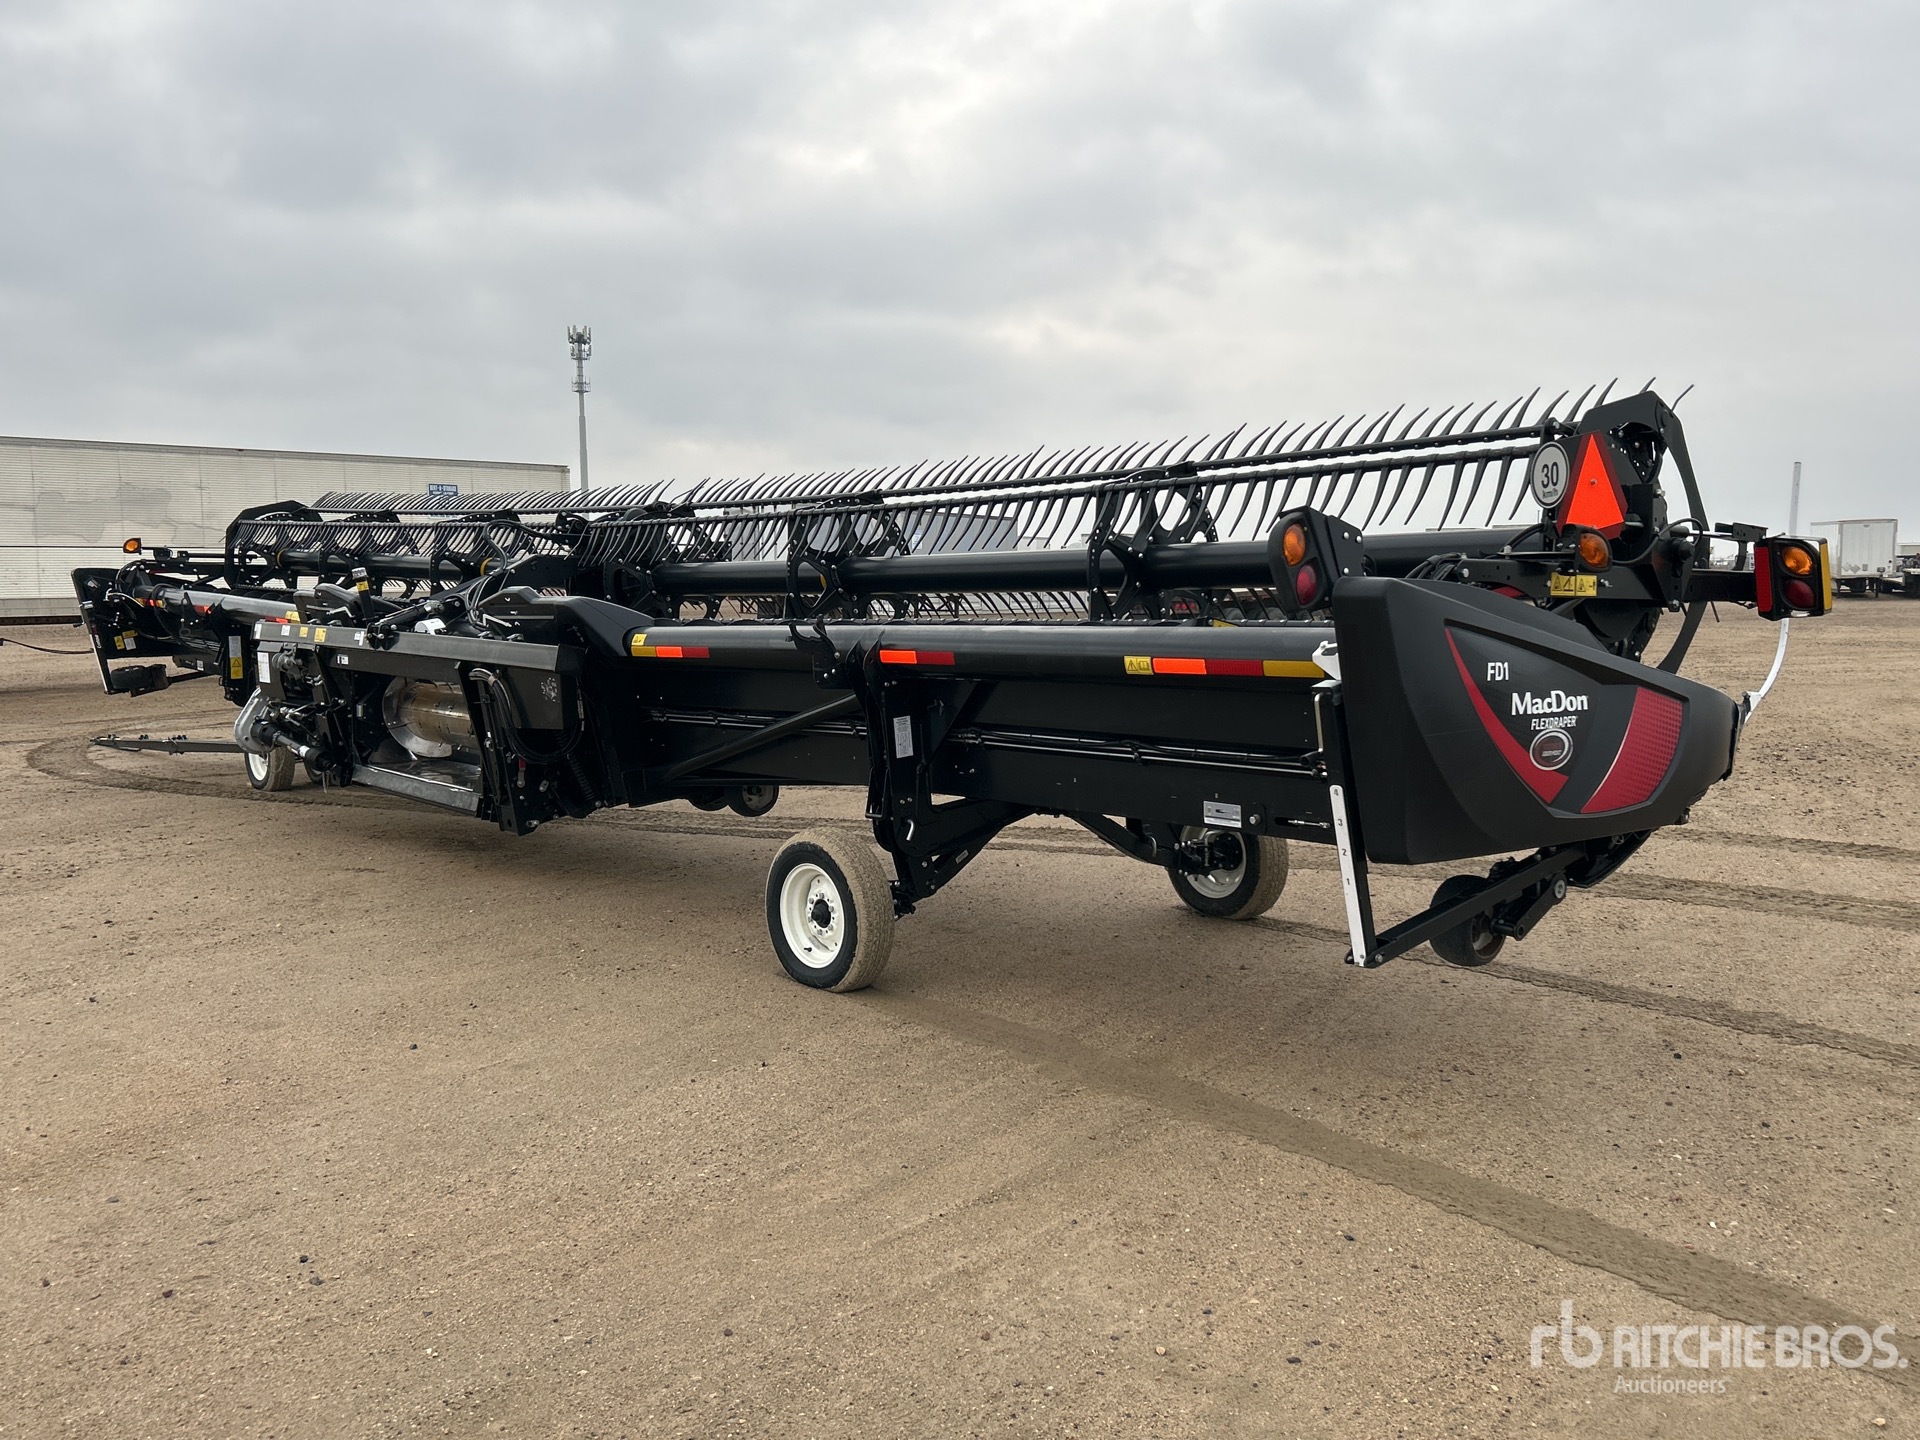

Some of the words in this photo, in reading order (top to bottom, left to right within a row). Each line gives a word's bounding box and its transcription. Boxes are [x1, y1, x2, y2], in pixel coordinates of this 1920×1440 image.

[1541, 462, 1559, 489] 30
[1487, 662, 1509, 681] FD1
[1511, 690, 1588, 715] MacDon
[1531, 716, 1577, 730] FLEXDRAPER
[1337, 818, 1343, 827] 3
[1341, 848, 1347, 856] 2
